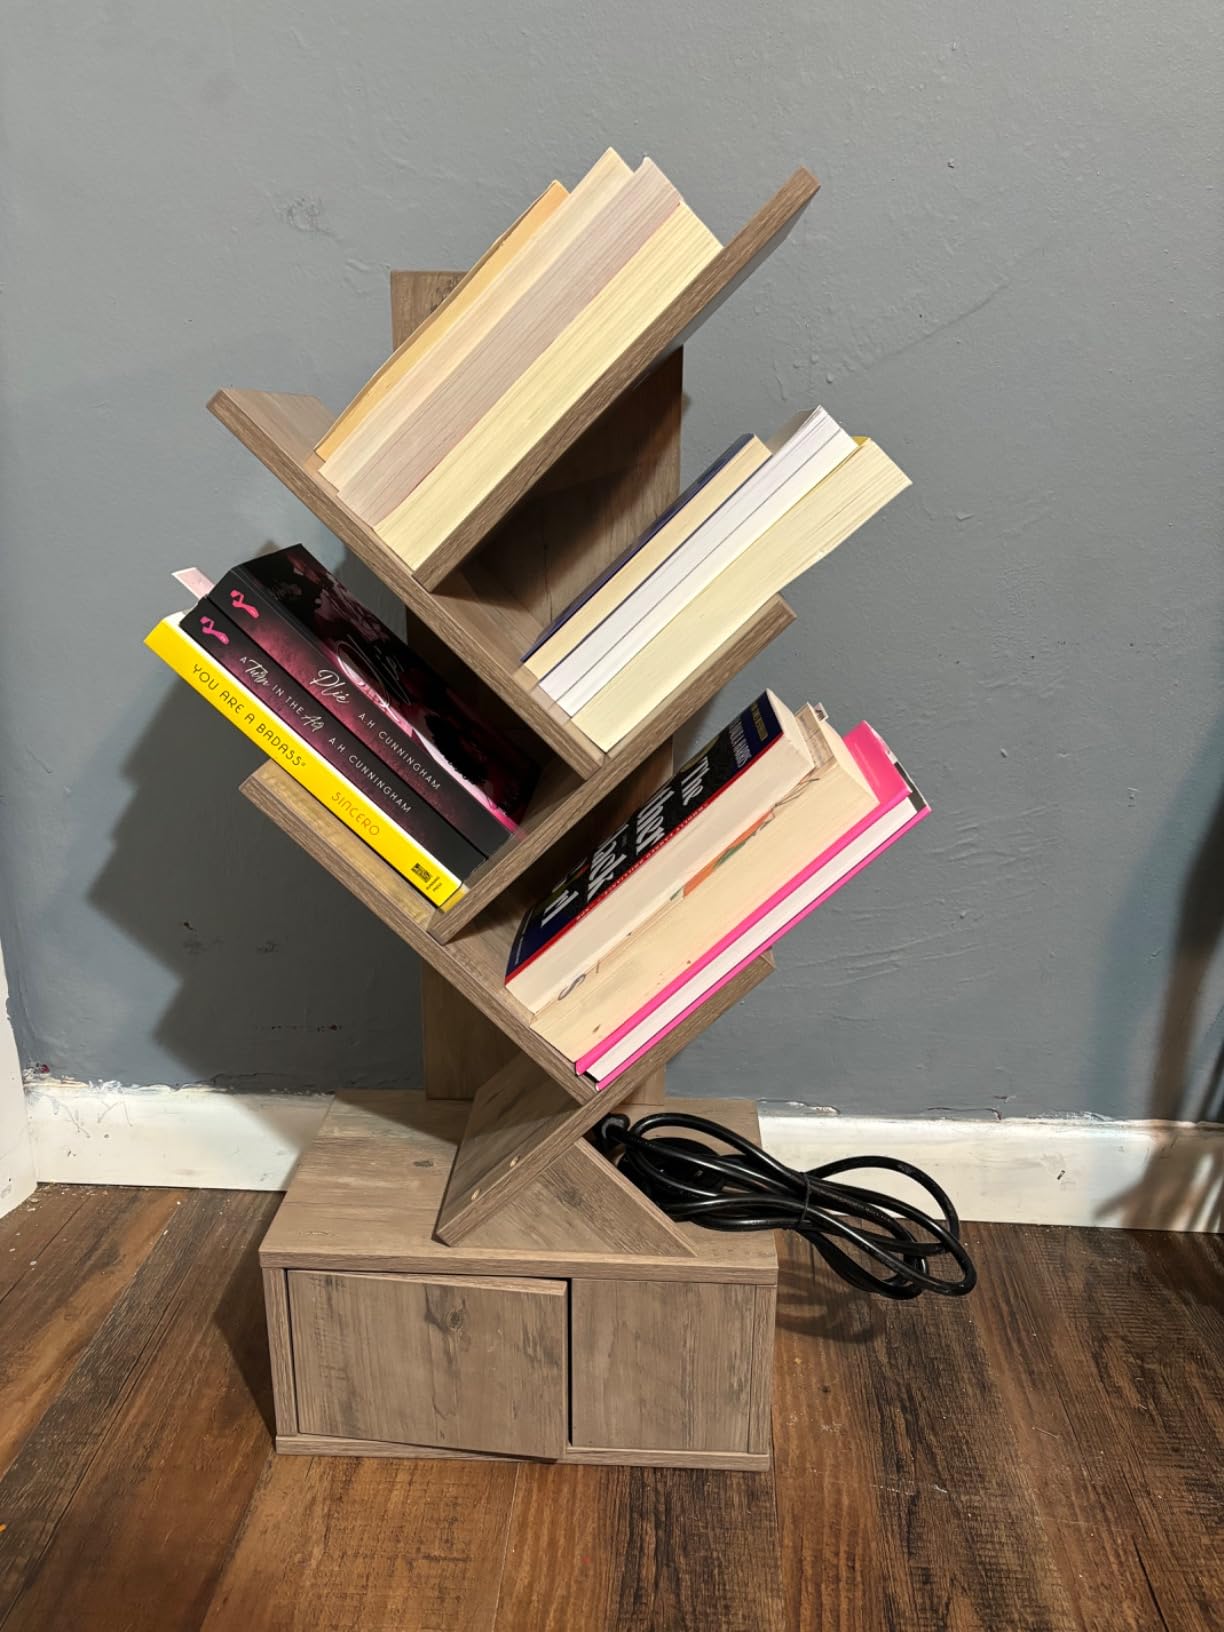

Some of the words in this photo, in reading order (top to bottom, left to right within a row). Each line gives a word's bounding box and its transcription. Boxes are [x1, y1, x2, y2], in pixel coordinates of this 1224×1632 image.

[193, 663, 219, 691] YOU
[219, 690, 245, 714] ARE
[244, 712, 255, 724] A
[331, 791, 380, 836] SINCERO
[240, 656, 247, 664] A
[272, 684, 285, 697] IN
[285, 696, 304, 715] THE
[348, 755, 412, 813] CUNNINGHAM
[378, 731, 441, 790] CUNNINGHAM
[681, 756, 711, 806] The
[634, 784, 676, 856] ther
[586, 823, 630, 902] lack
